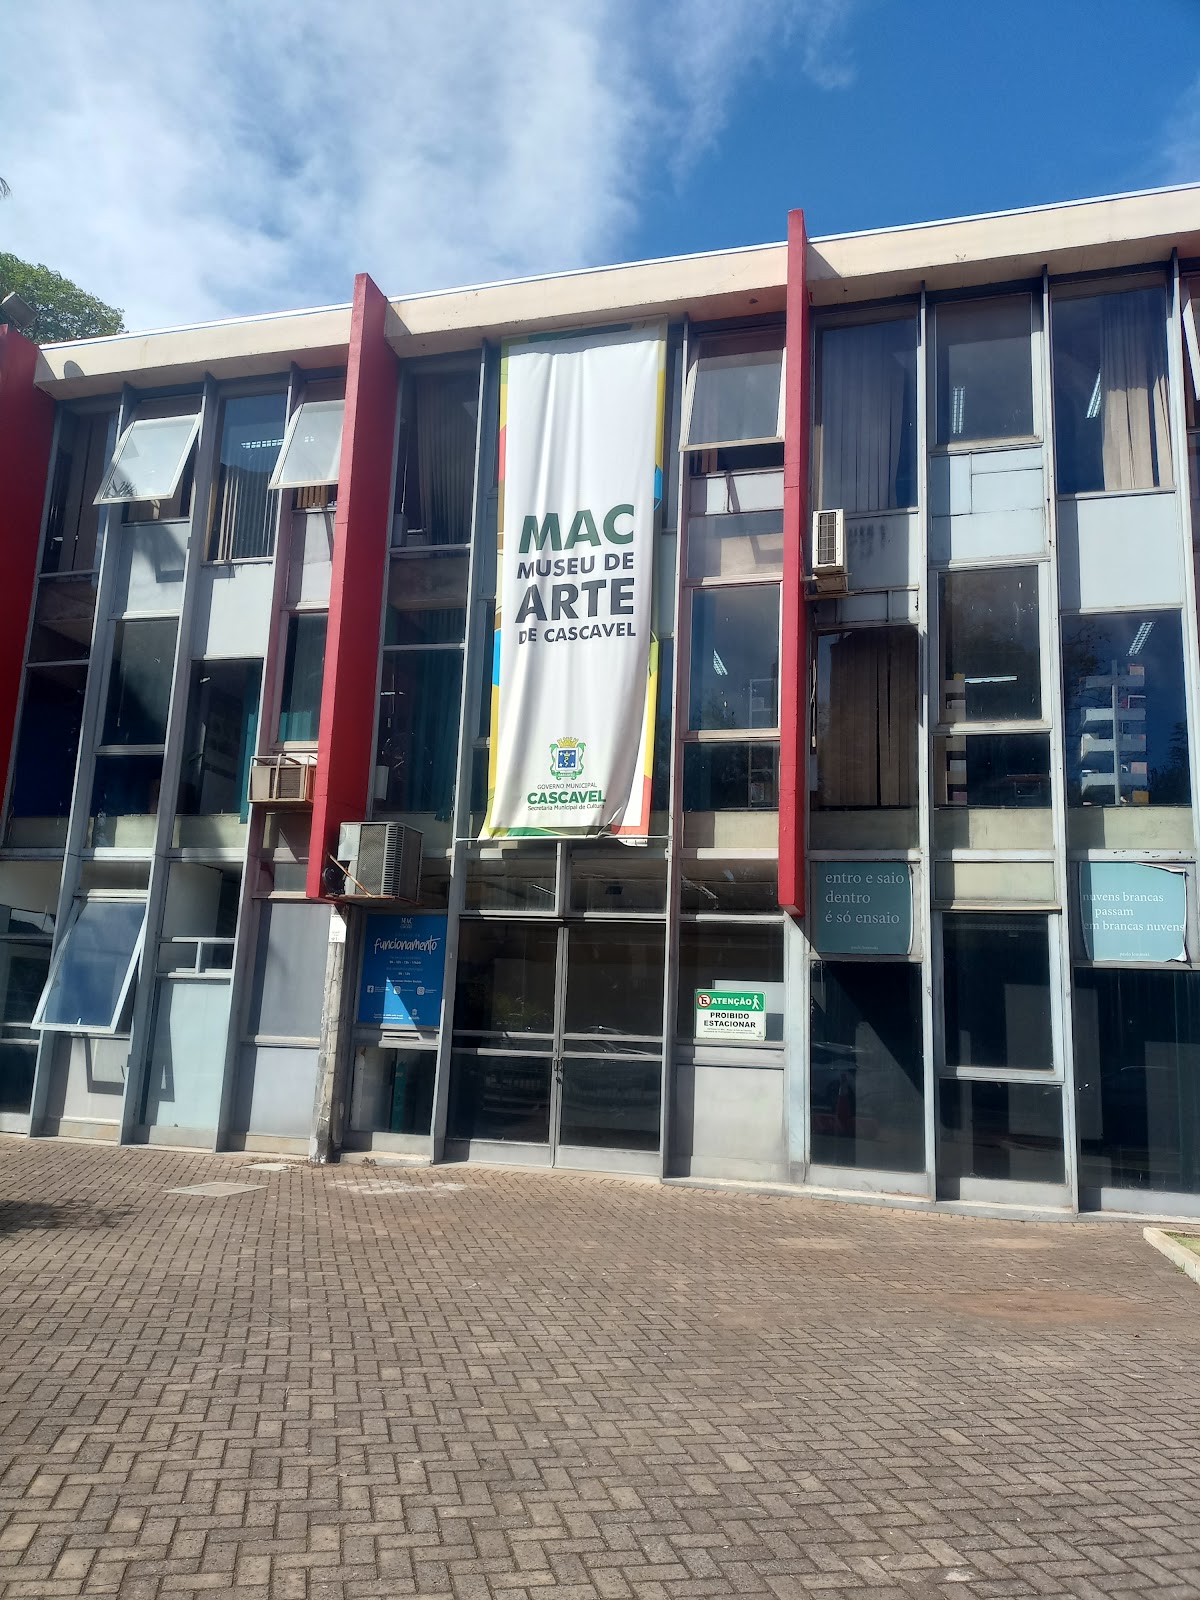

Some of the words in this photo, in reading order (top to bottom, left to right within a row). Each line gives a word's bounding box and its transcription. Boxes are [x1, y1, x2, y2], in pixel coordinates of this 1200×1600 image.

[518, 504, 634, 553] MAC
[517, 555, 595, 579] MUSEU
[604, 552, 634, 571] DE
[515, 578, 635, 623] ARTE
[519, 628, 537, 645] DE
[544, 623, 636, 643] CASCAVEL
[527, 790, 606, 804] CASCAVEL
[825, 873, 862, 884] entro
[866, 874, 873, 884] e
[877, 872, 904, 884] saio
[825, 890, 871, 904] dentro
[1082, 893, 1120, 902] nuvens
[1122, 891, 1164, 902] brancas
[825, 910, 833, 923] é
[836, 911, 852, 923] só
[855, 912, 900, 924] ensaio
[1095, 908, 1134, 918] passam
[1084, 922, 1100, 930] em
[1103, 921, 1144, 931] brancas
[1147, 924, 1184, 932] nuvens
[374, 935, 441, 955] funcionamento
[711, 997, 752, 1006] ATENÇÃO
[710, 1012, 750, 1020] PROIBIDO
[704, 1020, 756, 1028] ESTACIONAR
